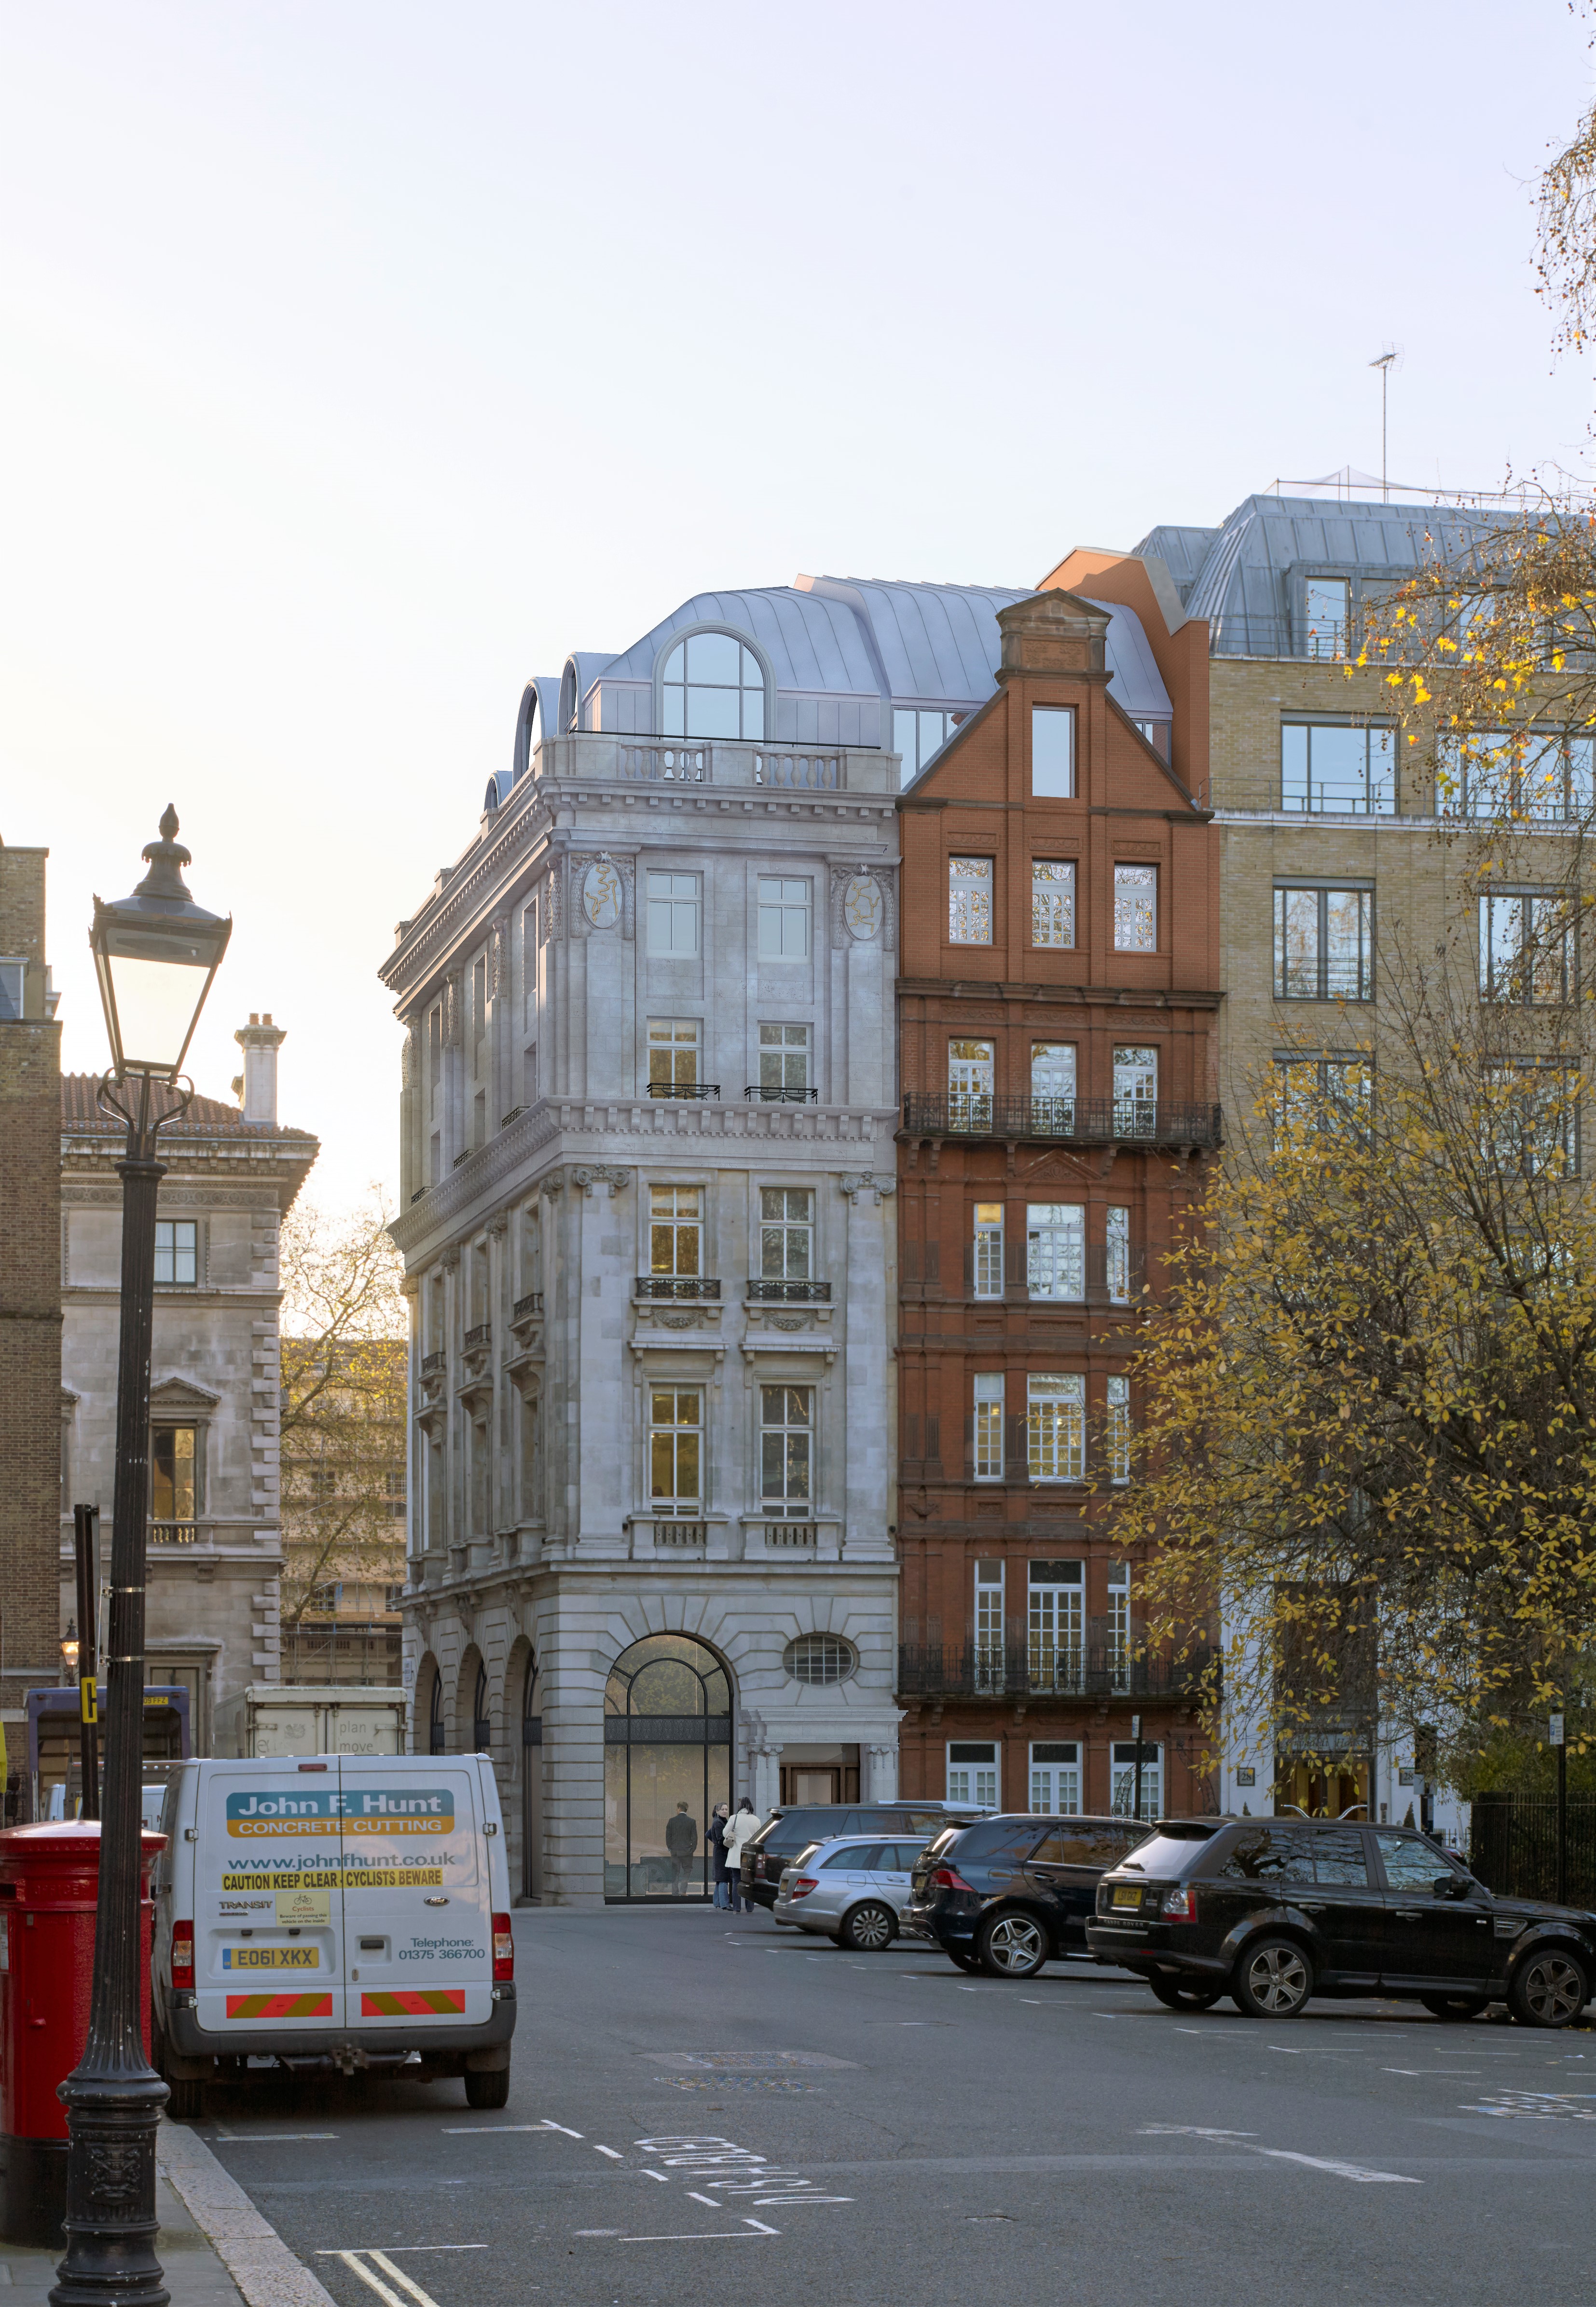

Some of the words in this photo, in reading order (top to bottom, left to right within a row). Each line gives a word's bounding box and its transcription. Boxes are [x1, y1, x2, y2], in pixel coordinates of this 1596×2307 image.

[340, 1720, 366, 1736] plan
[340, 1743, 373, 1752] move
[1241, 1772, 1252, 1781] 28
[238, 1797, 318, 1815] John
[329, 1795, 352, 1813] F.
[363, 1794, 441, 1813] Hunt
[238, 1821, 346, 1834] CONCRETE
[353, 1820, 441, 1832] CUTTING
[228, 1852, 455, 1871] www.johnfhunt.co.uk
[223, 1874, 270, 1890] CAUTION
[273, 1873, 300, 1889] KEEP
[304, 1872, 338, 1887] CLEAR
[346, 1871, 395, 1886] CYCLISTS
[399, 1870, 441, 1884] BEWARE
[219, 1900, 273, 1909] TRANSIT
[411, 1937, 474, 1949] Telephone:
[238, 1950, 275, 1965] EO61
[280, 1950, 312, 1965] XKX
[399, 1950, 434, 1960] 01375
[439, 1949, 485, 1959] 366700
[633, 2136, 858, 2205] DISABLED
